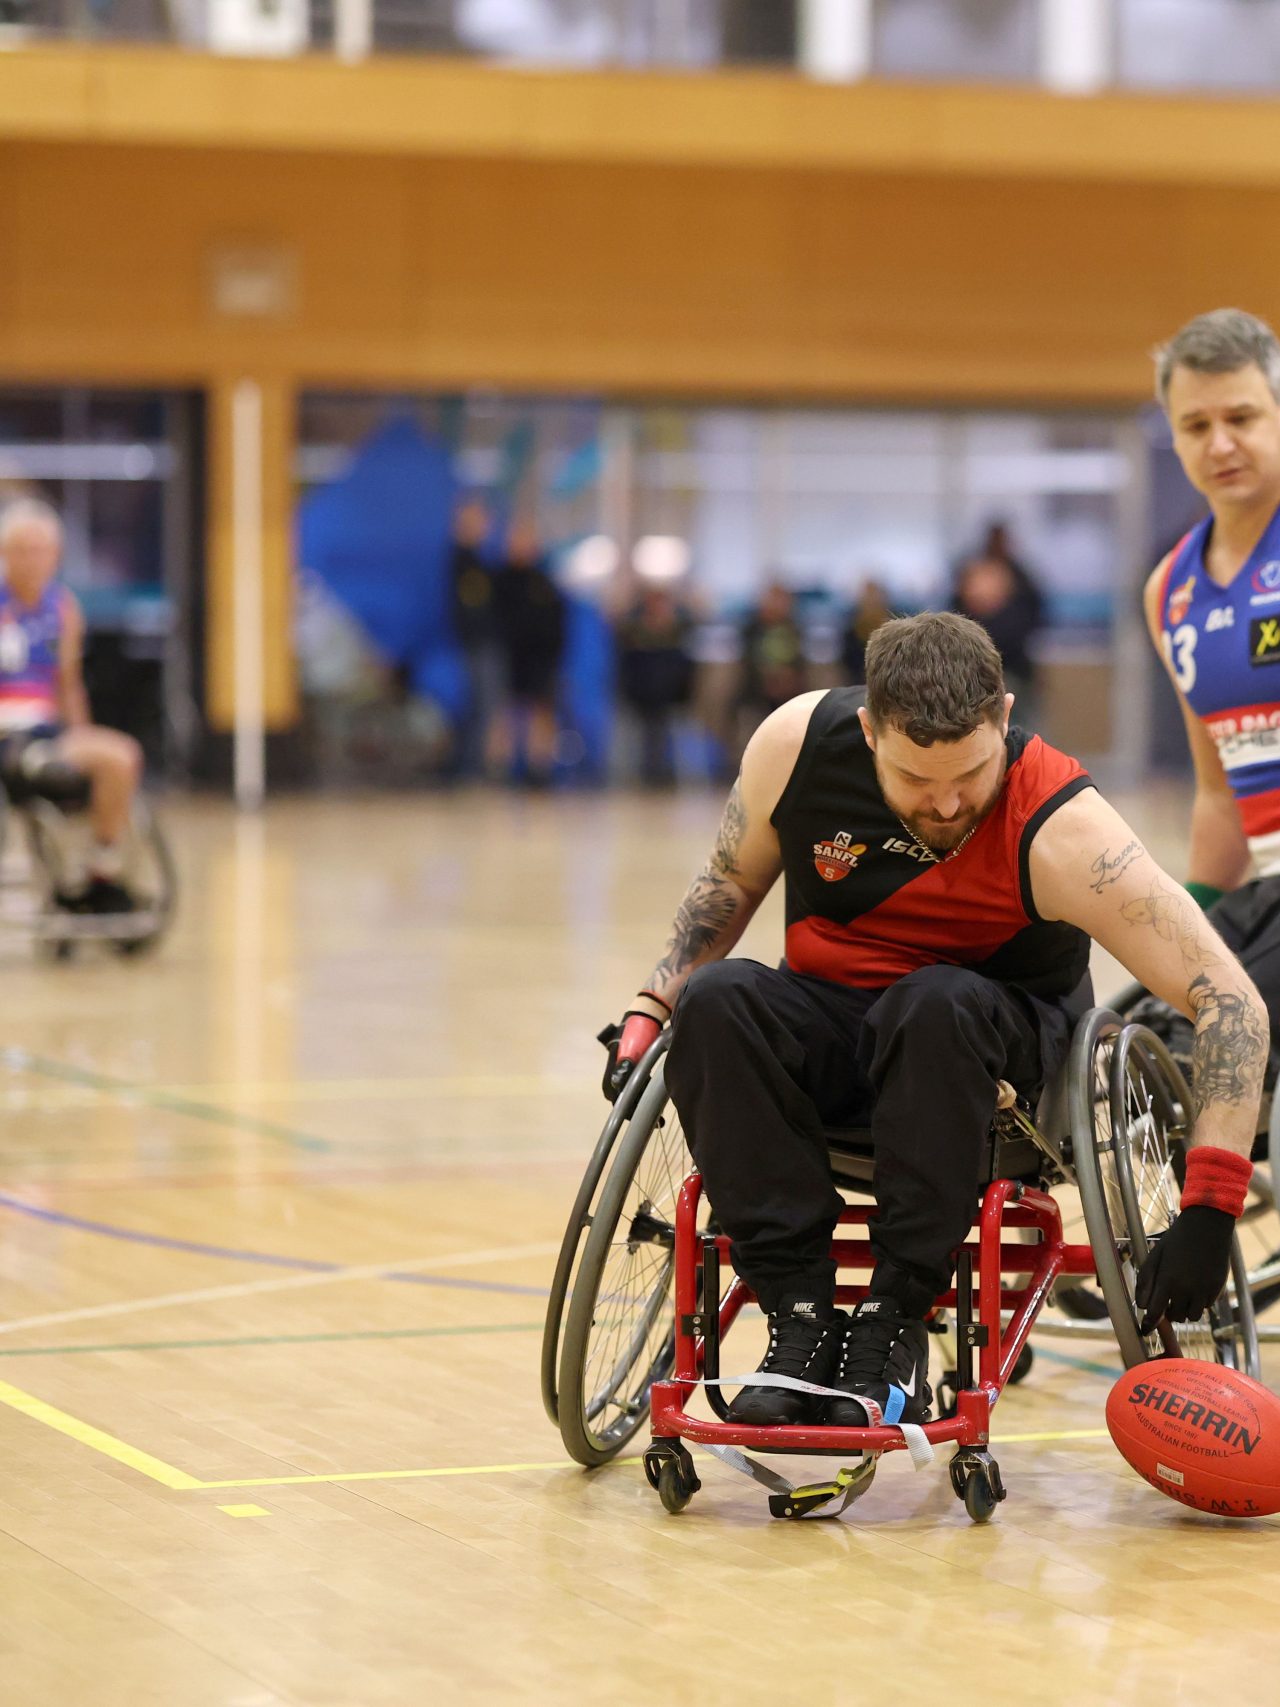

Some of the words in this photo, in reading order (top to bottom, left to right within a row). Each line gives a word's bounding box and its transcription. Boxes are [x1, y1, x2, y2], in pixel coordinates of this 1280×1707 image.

[813, 844, 859, 868] SANFL
[793, 1302, 815, 1313] NIKE
[859, 1302, 881, 1313] NIKE
[1128, 1383, 1261, 1455] SHERRIN
[1136, 1412, 1179, 1447] AUSTRALIAN
[1181, 1442, 1229, 1458] FOOTBALL
